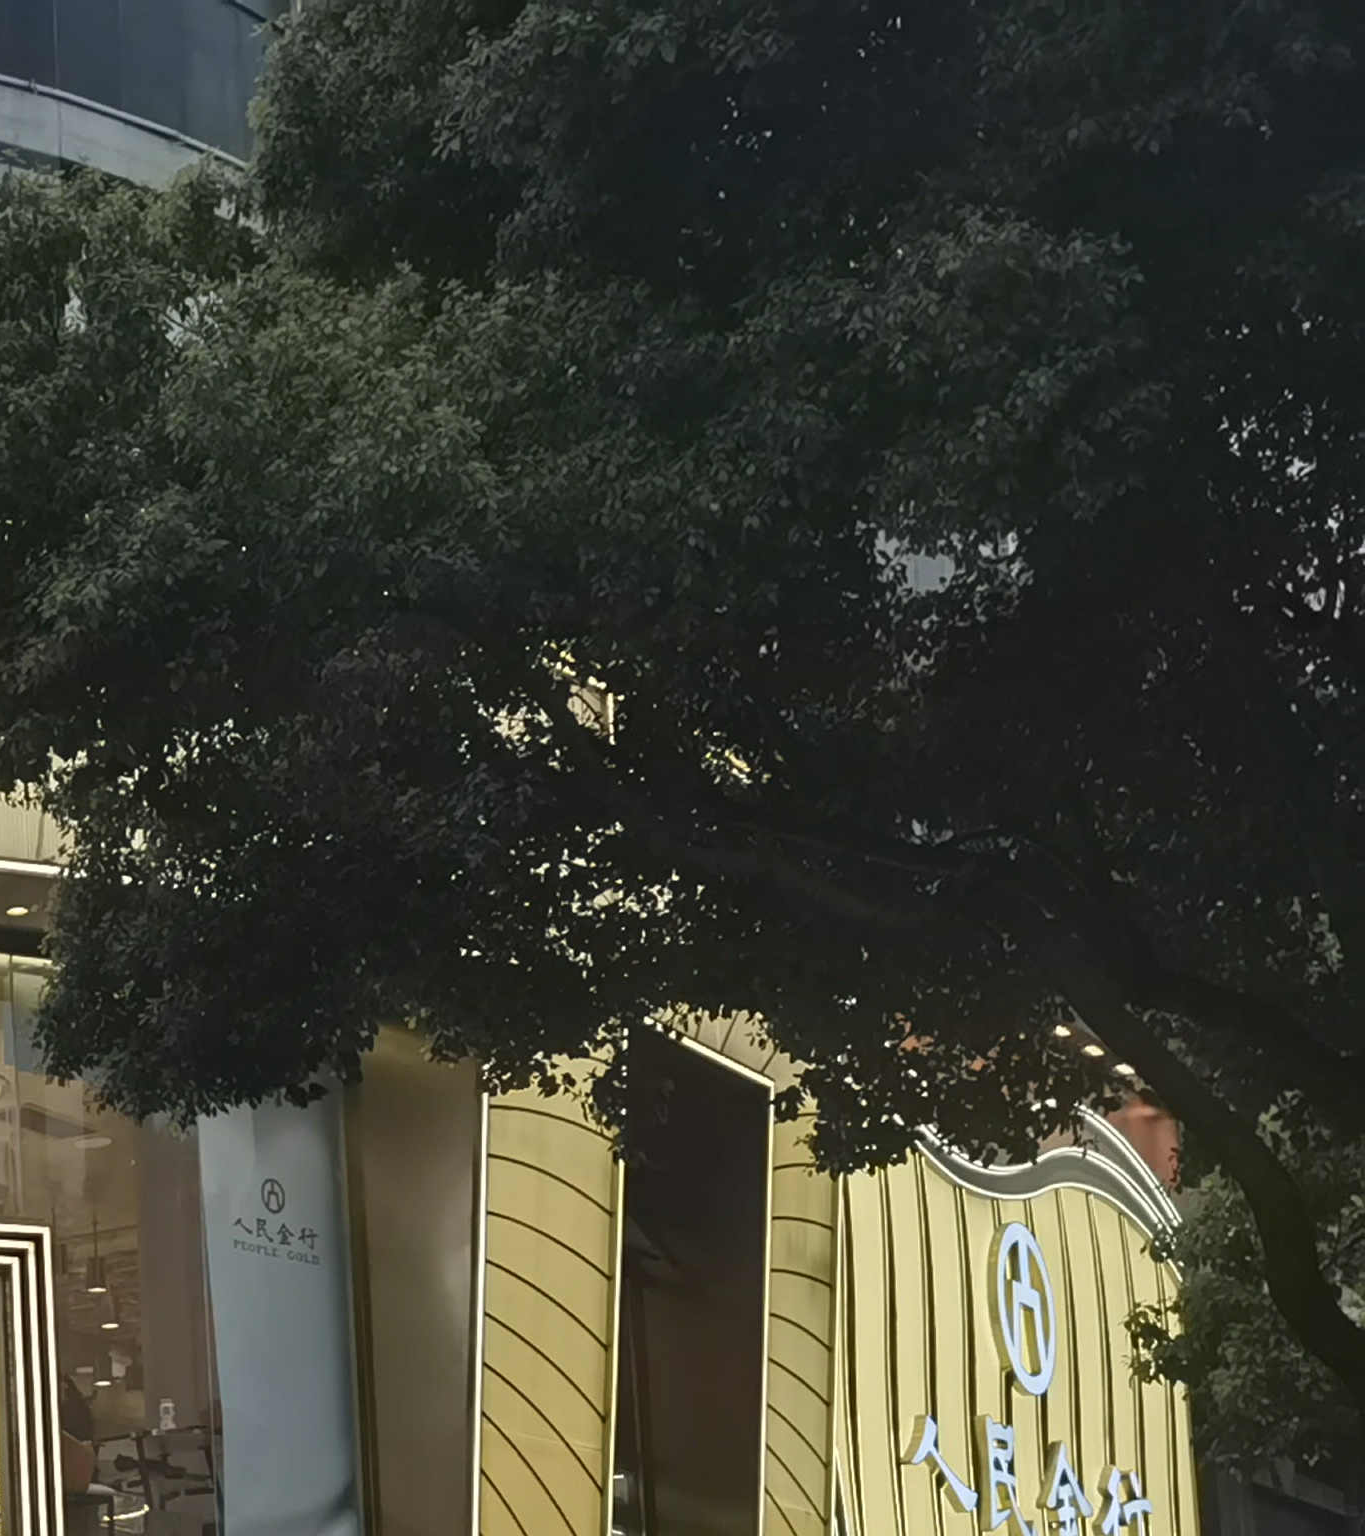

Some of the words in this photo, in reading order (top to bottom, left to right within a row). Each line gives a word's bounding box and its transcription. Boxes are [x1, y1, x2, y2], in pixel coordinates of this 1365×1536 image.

[233, 1217, 318, 1249] 人民金行
[233, 1239, 279, 1257] PEOPLE
[287, 1250, 320, 1265] GOLD
